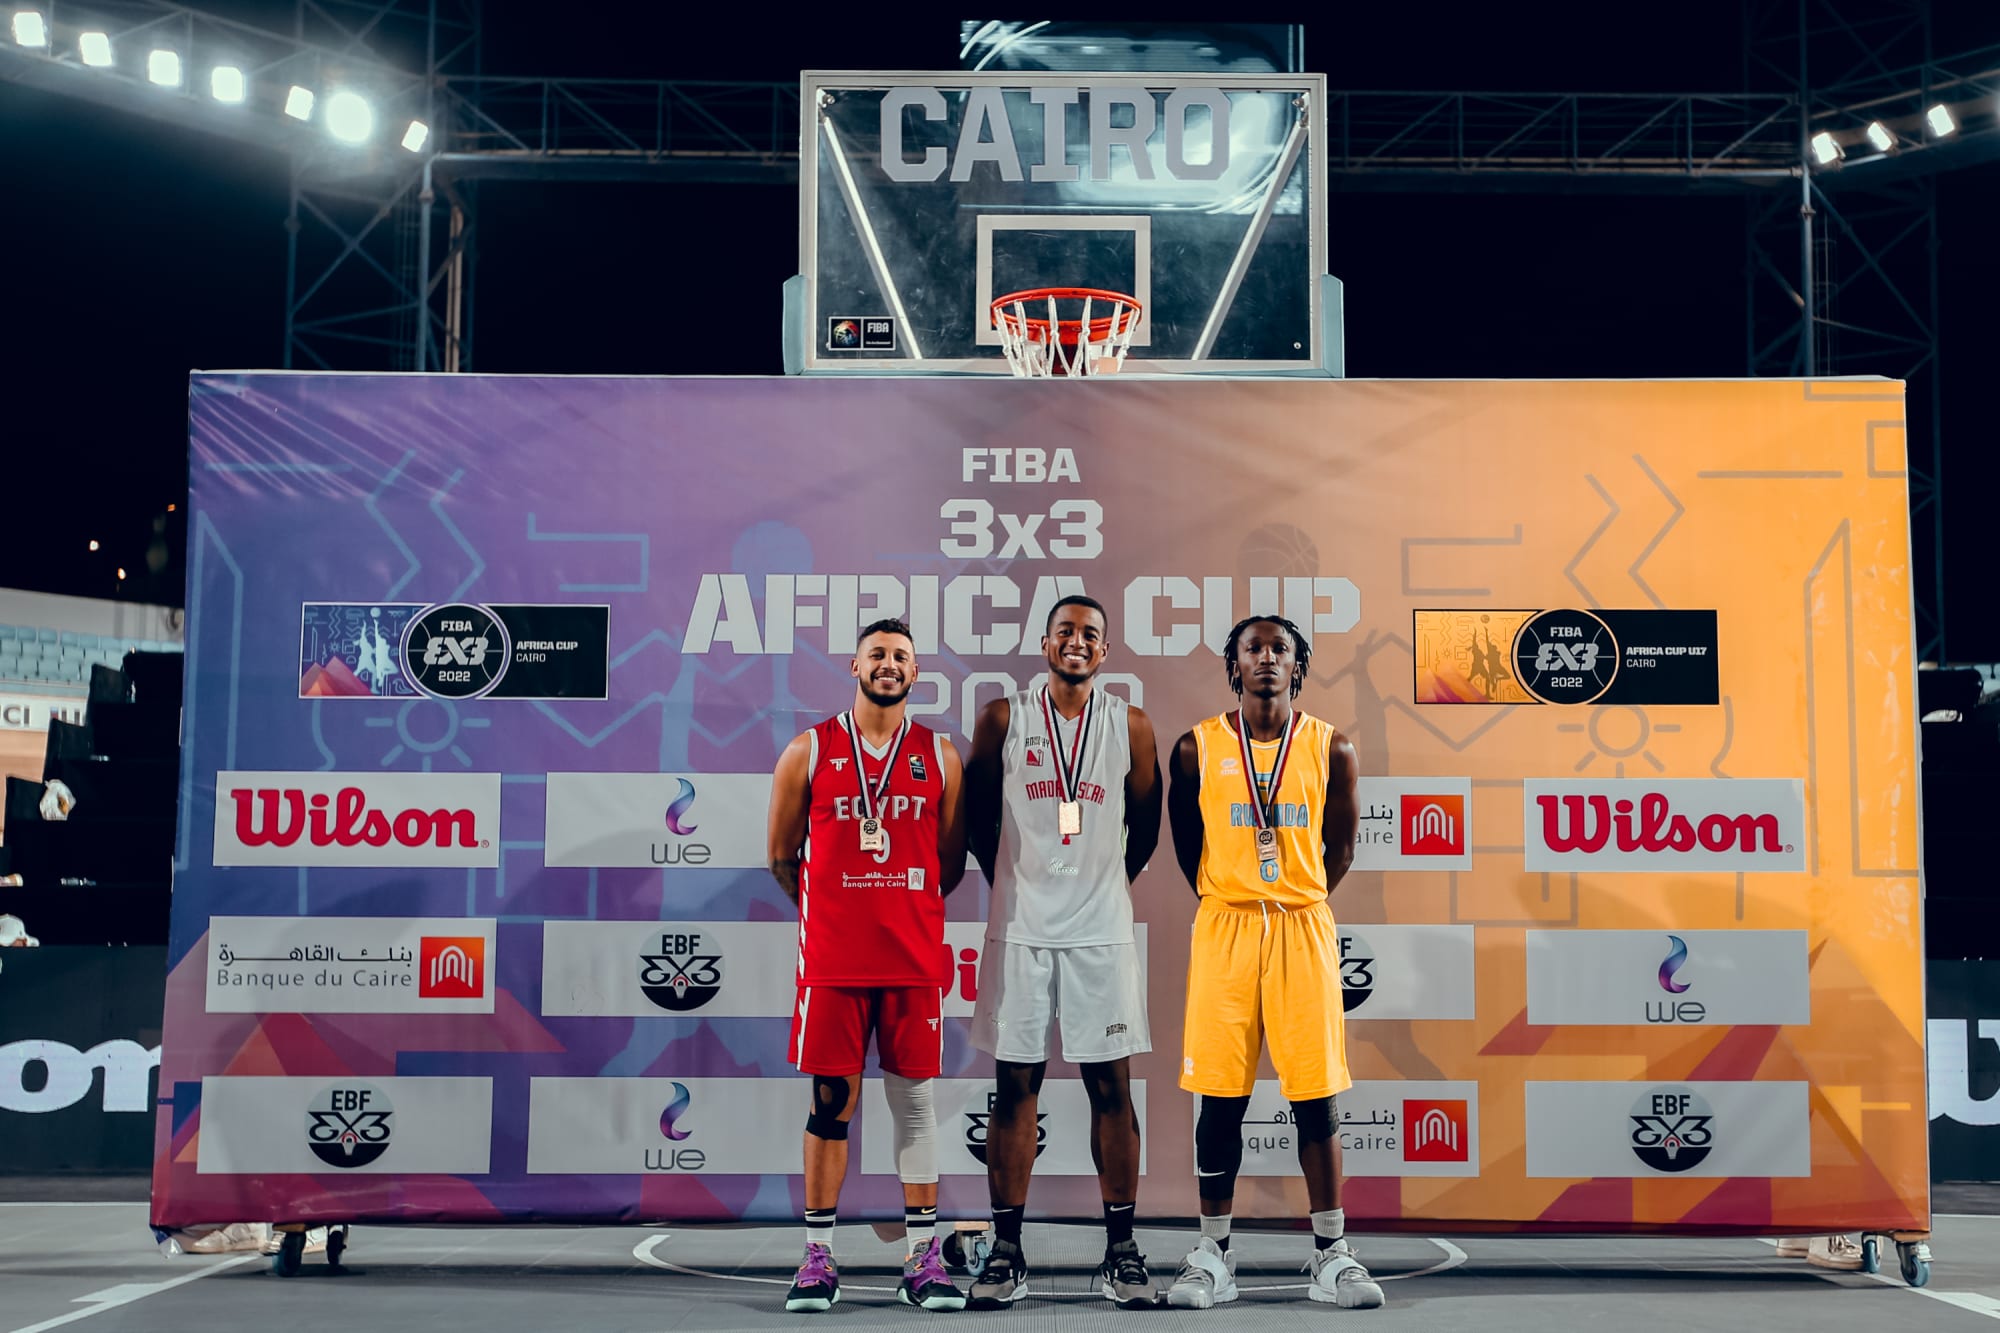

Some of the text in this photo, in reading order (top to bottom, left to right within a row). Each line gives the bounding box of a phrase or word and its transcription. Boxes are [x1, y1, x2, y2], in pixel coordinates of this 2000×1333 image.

[880, 86, 1231, 182] CAIRO
[867, 322, 889, 333] FIBA
[962, 447, 1081, 483] FIBA
[1124, 576, 1361, 656] CUP
[441, 620, 473, 632] FIBA
[1550, 626, 1583, 638] FIBA
[516, 641, 578, 651] AFRICA CUP
[1625, 646, 1707, 656] AFRICA CUP U17
[516, 653, 546, 663] CAIRO
[1626, 658, 1656, 668] CAIRO
[438, 670, 471, 682] 2022
[1551, 676, 1583, 687] 2022
[231, 787, 479, 848] Wilson
[1536, 793, 1783, 853] Wilson
[662, 934, 701, 955] EBF
[217, 969, 412, 990] Banque du Caire
[331, 1090, 371, 1111] EBF
[1652, 1094, 1691, 1115] EBF
[1340, 1133, 1396, 1150] Caire
